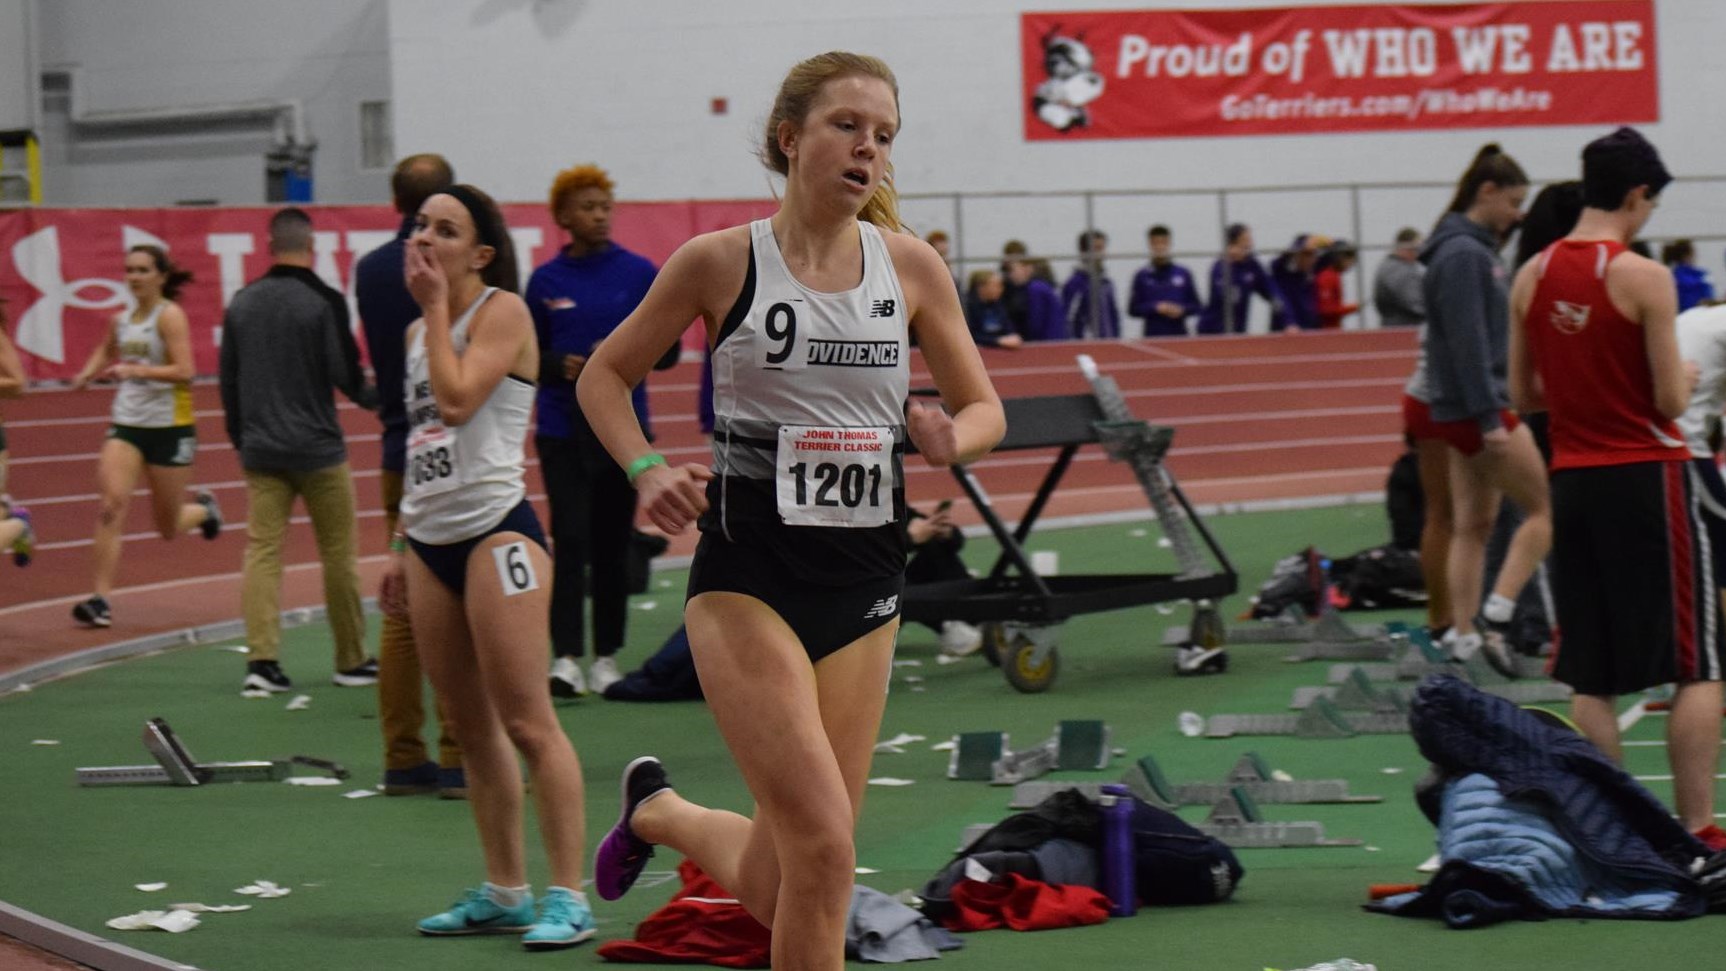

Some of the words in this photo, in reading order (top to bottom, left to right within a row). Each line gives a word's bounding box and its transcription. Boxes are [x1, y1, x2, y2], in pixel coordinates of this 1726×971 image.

[1117, 34, 1253, 79] Proud
[1262, 30, 1313, 83] of
[1323, 27, 1436, 78] WHO
[1453, 24, 1532, 74] WE
[1547, 21, 1643, 72] ARE
[765, 302, 796, 363] 9
[795, 441, 841, 451] TERRIER
[844, 443, 882, 452] CLASSIC
[803, 430, 834, 440] JOHN
[838, 431, 877, 440] THOMAS
[789, 462, 881, 508] 1201
[507, 546, 529, 590] 6
